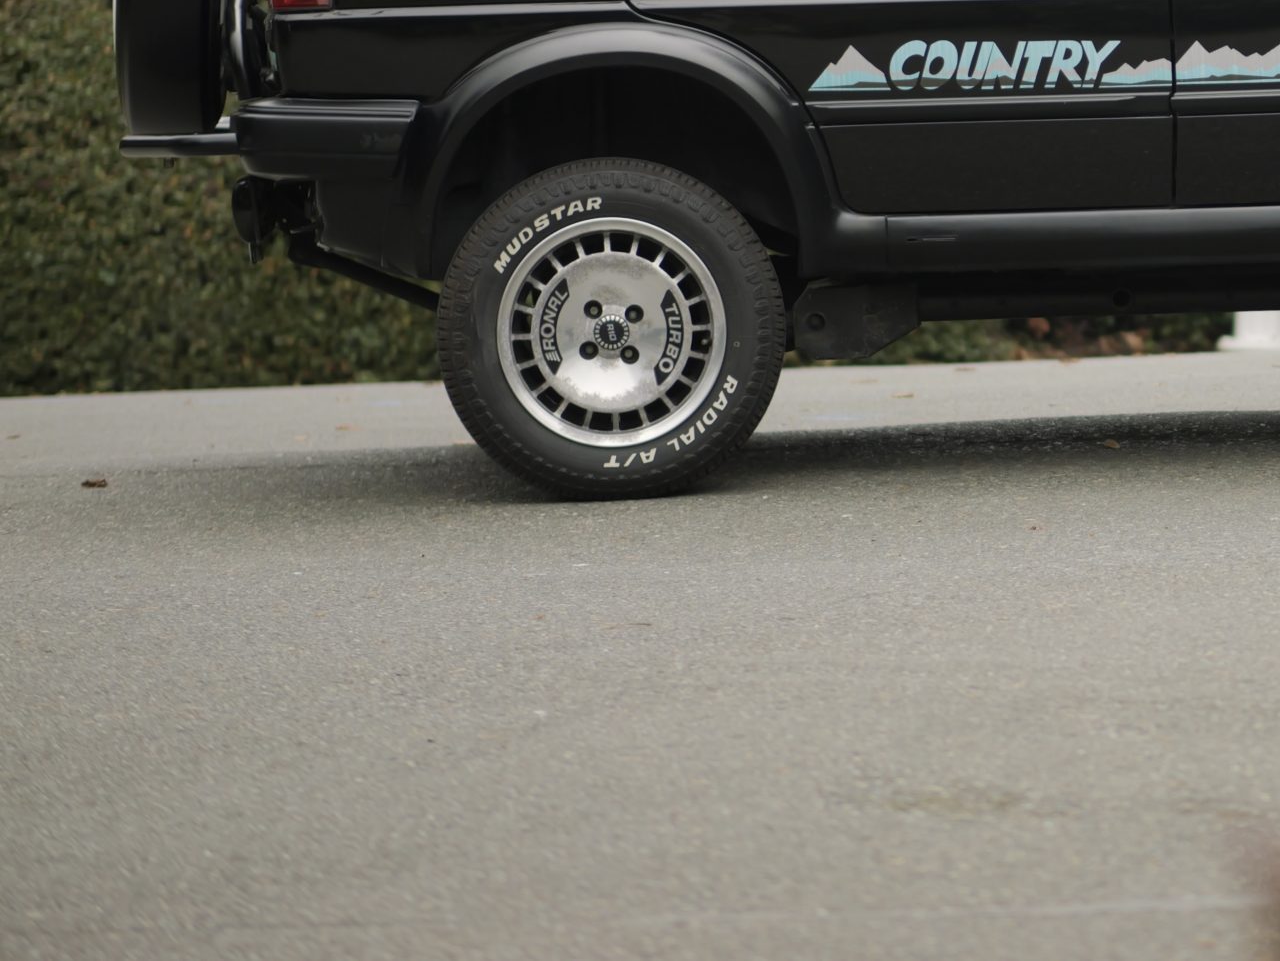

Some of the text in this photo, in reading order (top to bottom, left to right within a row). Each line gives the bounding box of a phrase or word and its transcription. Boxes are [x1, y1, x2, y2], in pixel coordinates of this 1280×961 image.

[889, 40, 1121, 90] COUNTRY
[493, 196, 602, 274] MUDSTAR
[541, 287, 569, 351] RONAL
[659, 302, 684, 374] TURBO
[603, 374, 739, 468] RADIAL A/T
